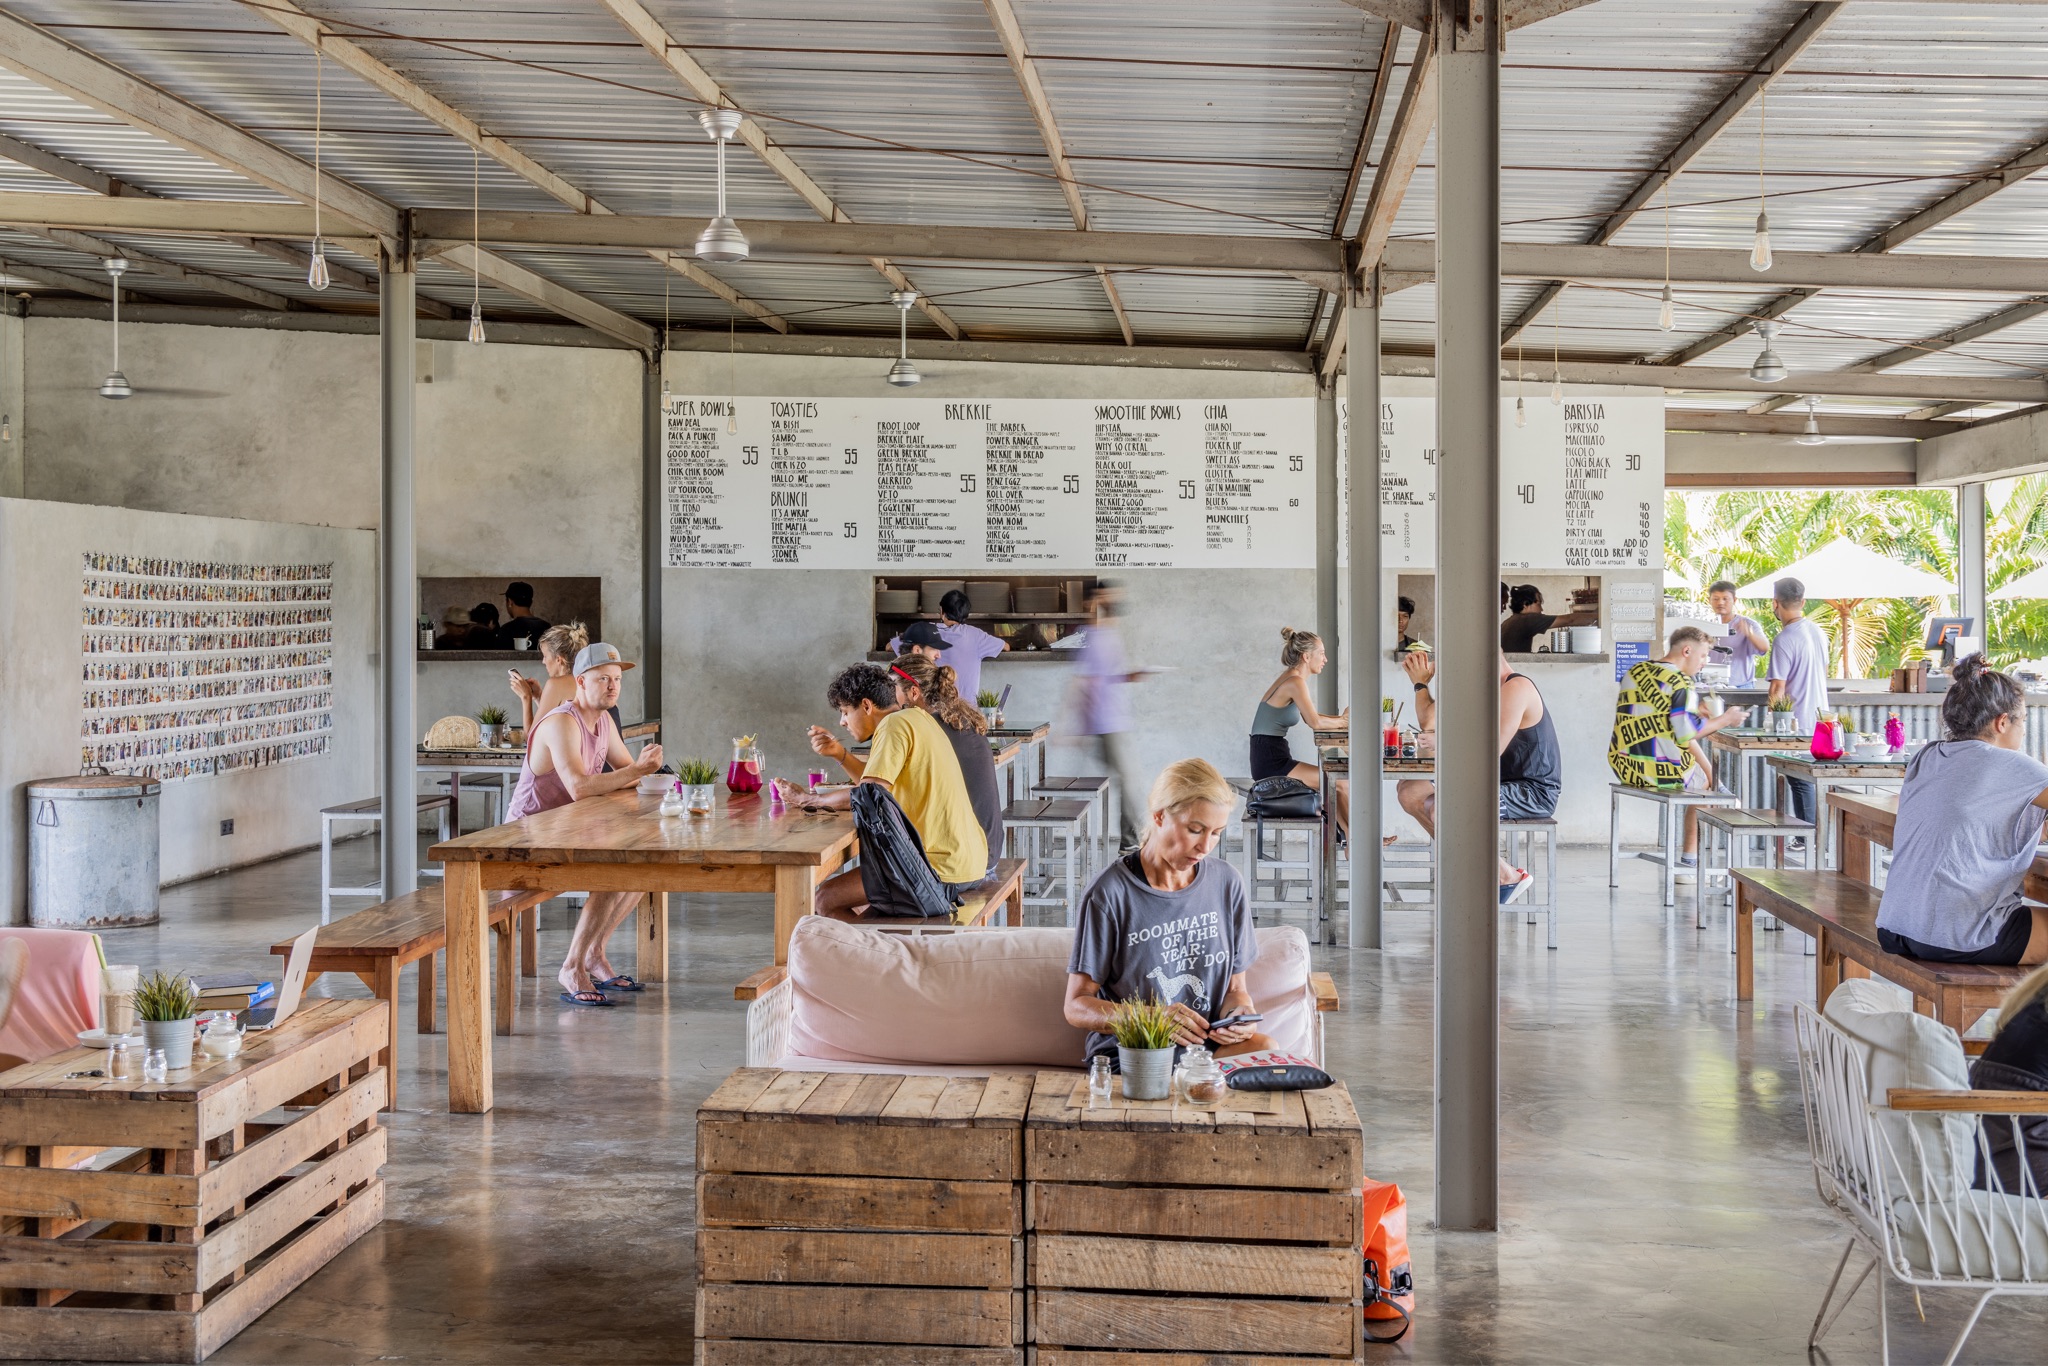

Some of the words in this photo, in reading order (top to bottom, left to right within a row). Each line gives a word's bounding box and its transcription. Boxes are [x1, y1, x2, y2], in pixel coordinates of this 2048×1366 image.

[701, 402, 731, 416] BOWLS
[771, 402, 818, 418] TOASTIES
[945, 404, 992, 420] BREKKIE
[1095, 405, 1146, 420] SMOOTHIE
[1151, 405, 1181, 420] BOWLS
[1205, 405, 1227, 419] CHIA
[1564, 404, 1605, 420] BARISTA
[668, 419, 683, 427] RAW
[685, 419, 700, 427] DEAL
[771, 420, 780, 428] YA
[878, 422, 900, 430] FROOT
[903, 422, 920, 430] LOOP
[986, 423, 998, 431] THE
[1000, 423, 1026, 431] BARBER
[1205, 423, 1219, 431] CHIA
[1221, 423, 1231, 431] BOI
[1096, 424, 1121, 432] HIPSTAR
[1565, 423, 1599, 433] ESPRESSO
[669, 432, 683, 440] PACK
[686, 432, 691, 440] A
[694, 432, 715, 441] PUNCH
[772, 434, 796, 442] SAMBO
[878, 435, 903, 443] BREKKIE
[906, 436, 924, 444] PLATE
[1566, 435, 1605, 445] MACCHIATO
[986, 437, 1010, 445] POWER
[1013, 437, 1039, 445] RANGER
[1115, 443, 1123, 451] SO
[1125, 443, 1148, 451] CEREAL
[1206, 442, 1231, 450] PUCKER
[1233, 442, 1241, 450] UP
[667, 450, 688, 458] GOOD
[691, 450, 709, 458] ROOT
[743, 446, 758, 465] 55
[784, 448, 788, 456] B
[878, 449, 899, 457] GREEN
[902, 450, 927, 458] BREKKIE
[986, 450, 1012, 458] BREKKIE
[1023, 451, 1044, 459] BREAD
[1566, 448, 1594, 456] PICCOLO
[845, 449, 857, 464] 55
[1206, 456, 1227, 464] SWEET
[1229, 456, 1240, 464] ASS
[1096, 461, 1115, 469] BLACK
[1118, 461, 1132, 469] OUT
[1289, 456, 1303, 471] 55
[1566, 458, 1587, 467] LONG
[1588, 458, 1611, 468] BLACK
[1625, 455, 1641, 470] 30
[878, 463, 893, 472] PEAS
[896, 464, 918, 472] PLEASE
[987, 464, 997, 472] MR
[1000, 464, 1018, 472] BEAN
[685, 468, 700, 476] CHIK
[703, 468, 724, 476] BOOM
[1205, 470, 1233, 478] CLUSTER
[1566, 468, 1582, 479] FLAT
[1585, 468, 1608, 479] WHITE
[771, 475, 794, 483] HALLO
[798, 475, 808, 483] ME
[960, 474, 976, 492] 55
[1064, 475, 1079, 493] 55
[1096, 479, 1138, 488] BOWLARAMA
[1566, 479, 1586, 489] LATTE
[1179, 480, 1195, 499] 55
[1205, 484, 1223, 492] GREEN
[1225, 484, 1251, 492] MACHINE
[878, 490, 898, 498] VETO
[987, 490, 1003, 498] ROLL
[1006, 490, 1023, 498] OVER
[1393, 492, 1414, 500] SHAKE
[1517, 485, 1535, 503] 40
[1565, 490, 1603, 500] CAPPUCCINO
[771, 491, 807, 507] BRUNCH
[1289, 499, 1299, 507] 60
[670, 504, 679, 512] THE
[683, 504, 700, 512] PEDRO
[878, 504, 915, 512] EGGXLENT
[987, 504, 1020, 512] SHROOMS
[1566, 501, 1590, 509] MOCHA
[1639, 502, 1650, 511] 40
[772, 509, 782, 517] IT'S
[791, 509, 809, 517] WRAP
[1566, 510, 1574, 518] ICE
[1576, 510, 1594, 519] LATTE
[1639, 512, 1649, 520] 40
[670, 517, 690, 525] CURRY
[693, 517, 716, 525] MUNCH
[879, 517, 892, 525] THE
[895, 517, 928, 525] MELVILLE
[987, 517, 1003, 525] NOM
[1096, 516, 1143, 524] MANGOLICIOUS
[1206, 514, 1249, 524] MUNCHIES
[1639, 521, 1649, 529] 40
[844, 523, 857, 538] 55
[879, 530, 894, 538] KISS
[1566, 529, 1585, 537] DIRTY
[1588, 529, 1602, 537] CHAI
[1640, 530, 1650, 538] 40
[986, 531, 1010, 539] SHREGG
[1096, 534, 1108, 542] MIX
[1110, 534, 1119, 542] UP
[772, 536, 801, 545] PERKKIE
[1623, 539, 1637, 548] ADD
[1639, 539, 1648, 548] 10
[986, 545, 1015, 553] FRENCHY
[1565, 548, 1587, 557] CRATE
[1591, 548, 1609, 557] COLD
[1613, 548, 1633, 557] BREW
[1639, 549, 1648, 557] 40
[772, 550, 797, 558] STONER
[1566, 558, 1590, 566] VGATO
[1638, 558, 1647, 566] 45
[1128, 912, 1218, 946] ROOMMATE
[1162, 934, 1182, 950] OF
[1187, 926, 1218, 943] THE
[1160, 943, 1206, 964] YEAR:
[1175, 957, 1198, 974] MY
